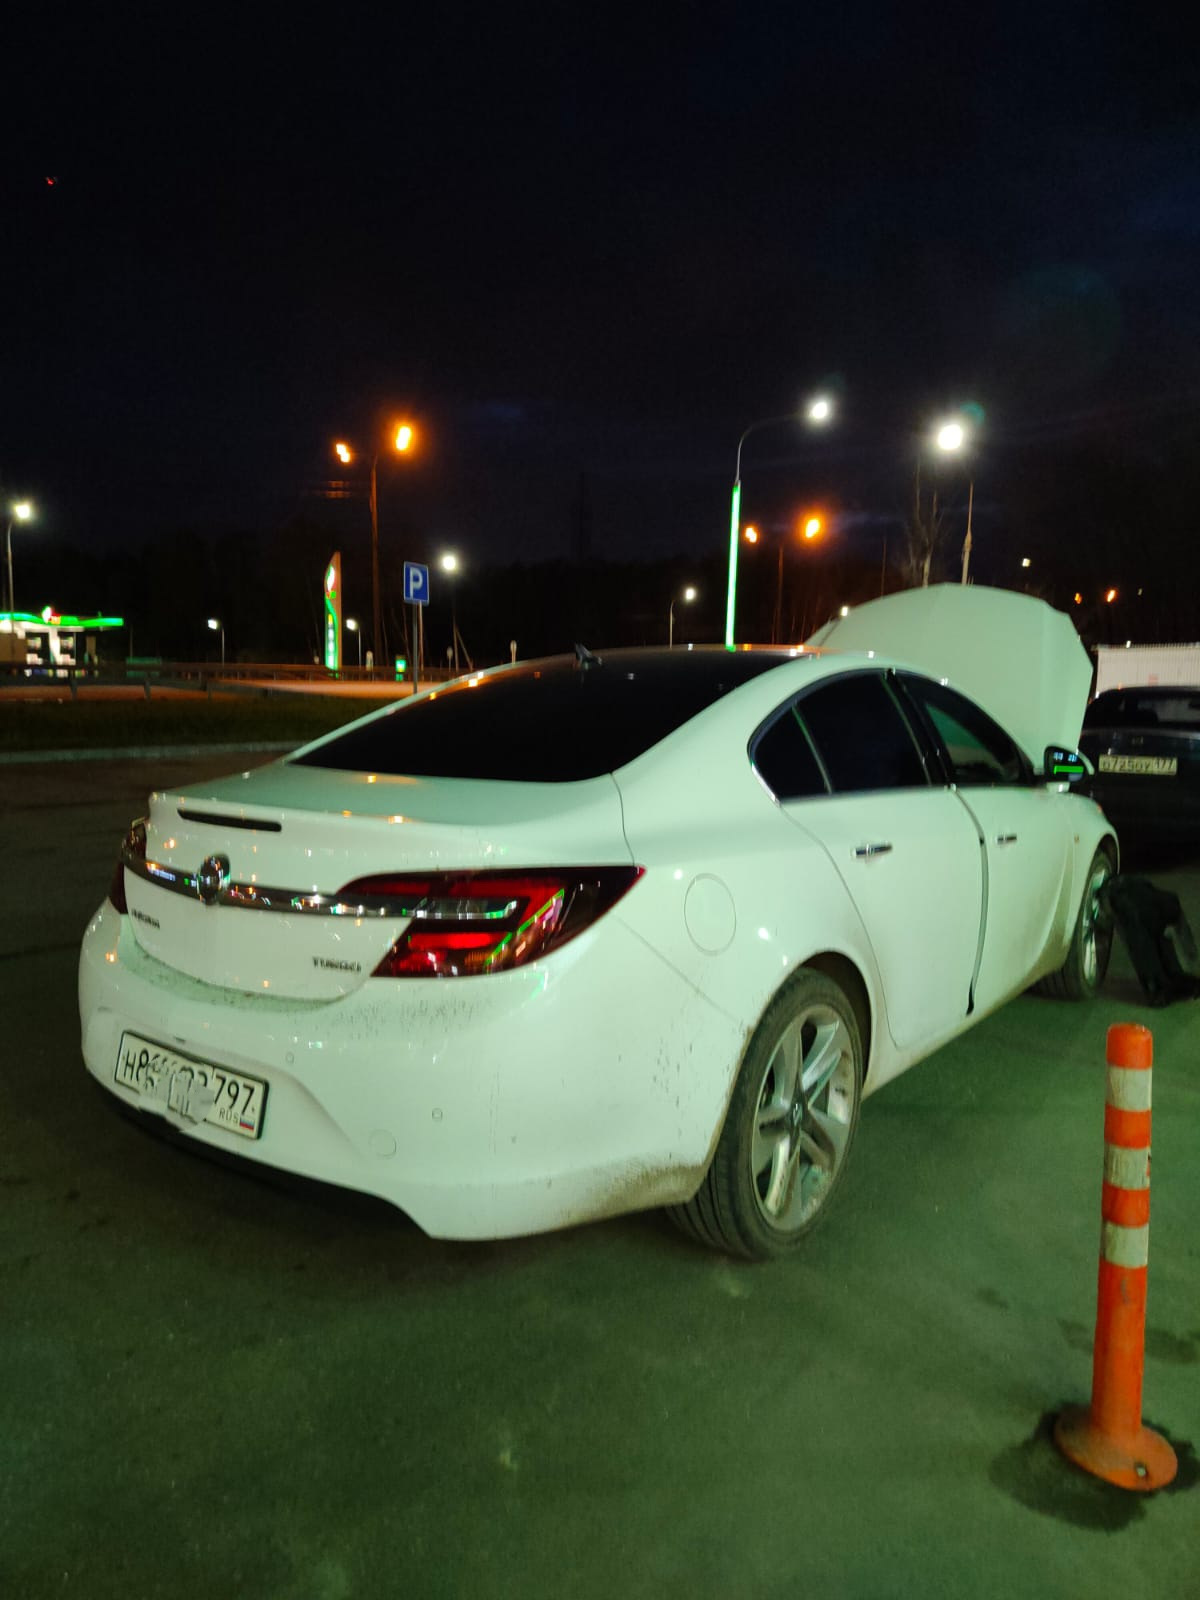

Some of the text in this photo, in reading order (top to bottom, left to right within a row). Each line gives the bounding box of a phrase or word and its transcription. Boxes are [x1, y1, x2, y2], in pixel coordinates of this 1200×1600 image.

[410, 566, 423, 599] P
[214, 1073, 255, 1116] 797
[218, 1107, 240, 1124] RUS
